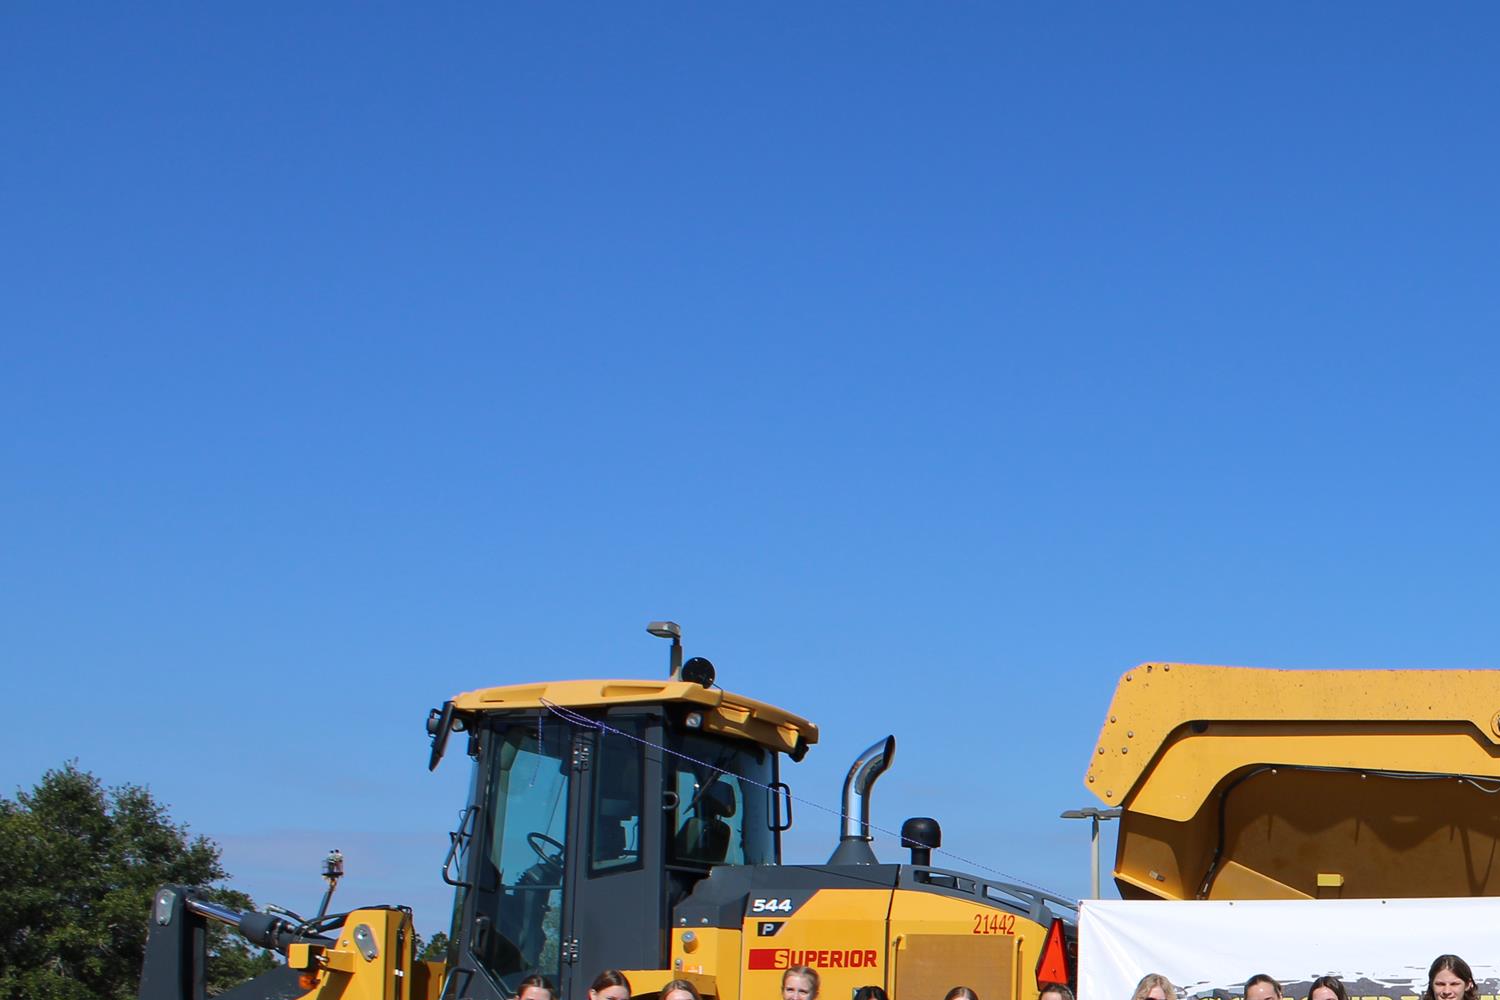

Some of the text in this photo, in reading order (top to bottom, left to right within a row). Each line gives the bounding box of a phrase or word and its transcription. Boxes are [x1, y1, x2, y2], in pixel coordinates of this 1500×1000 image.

[752, 898, 792, 912] 544
[762, 923, 775, 935] P
[973, 914, 1015, 935] 21442
[774, 949, 878, 969] SUPERIOR
